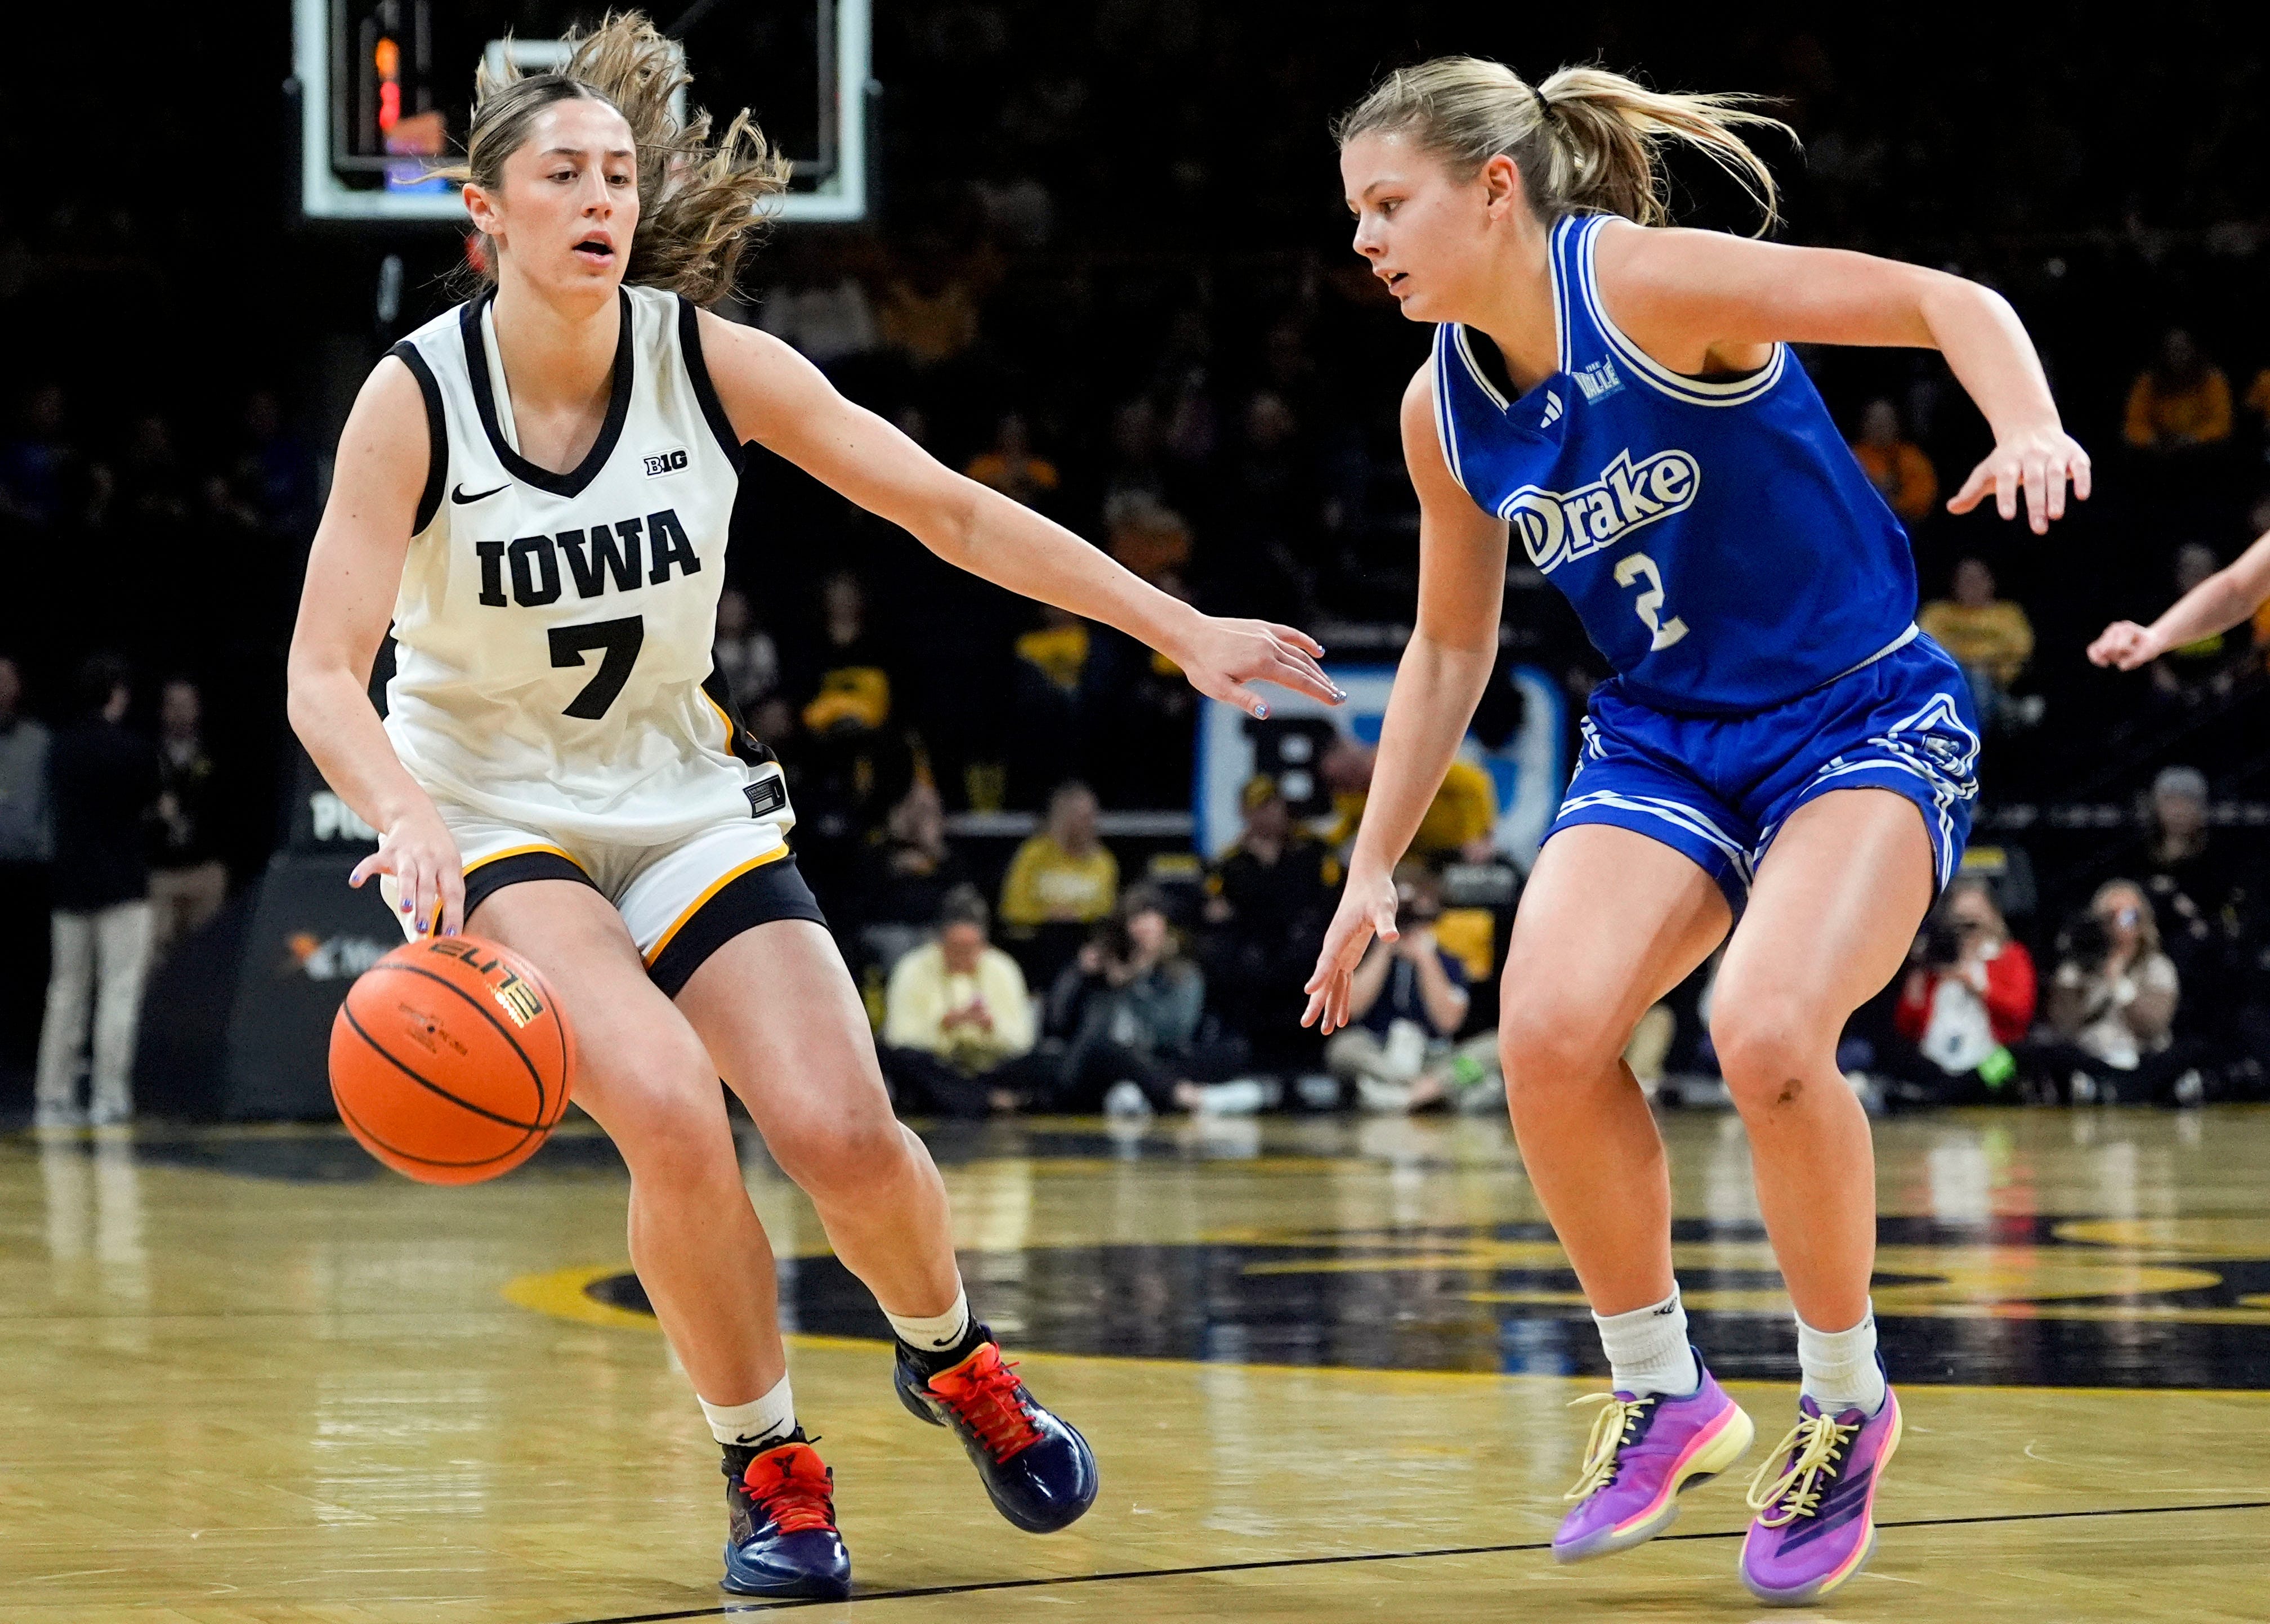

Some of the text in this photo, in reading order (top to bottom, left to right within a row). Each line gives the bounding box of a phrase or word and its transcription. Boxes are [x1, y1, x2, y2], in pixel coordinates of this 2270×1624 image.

[476, 508, 701, 607] IOWA
[1501, 453, 1696, 570] Drake
[1614, 552, 1690, 652] 2
[547, 614, 644, 720] 7
[429, 939, 545, 1024] ELITE
